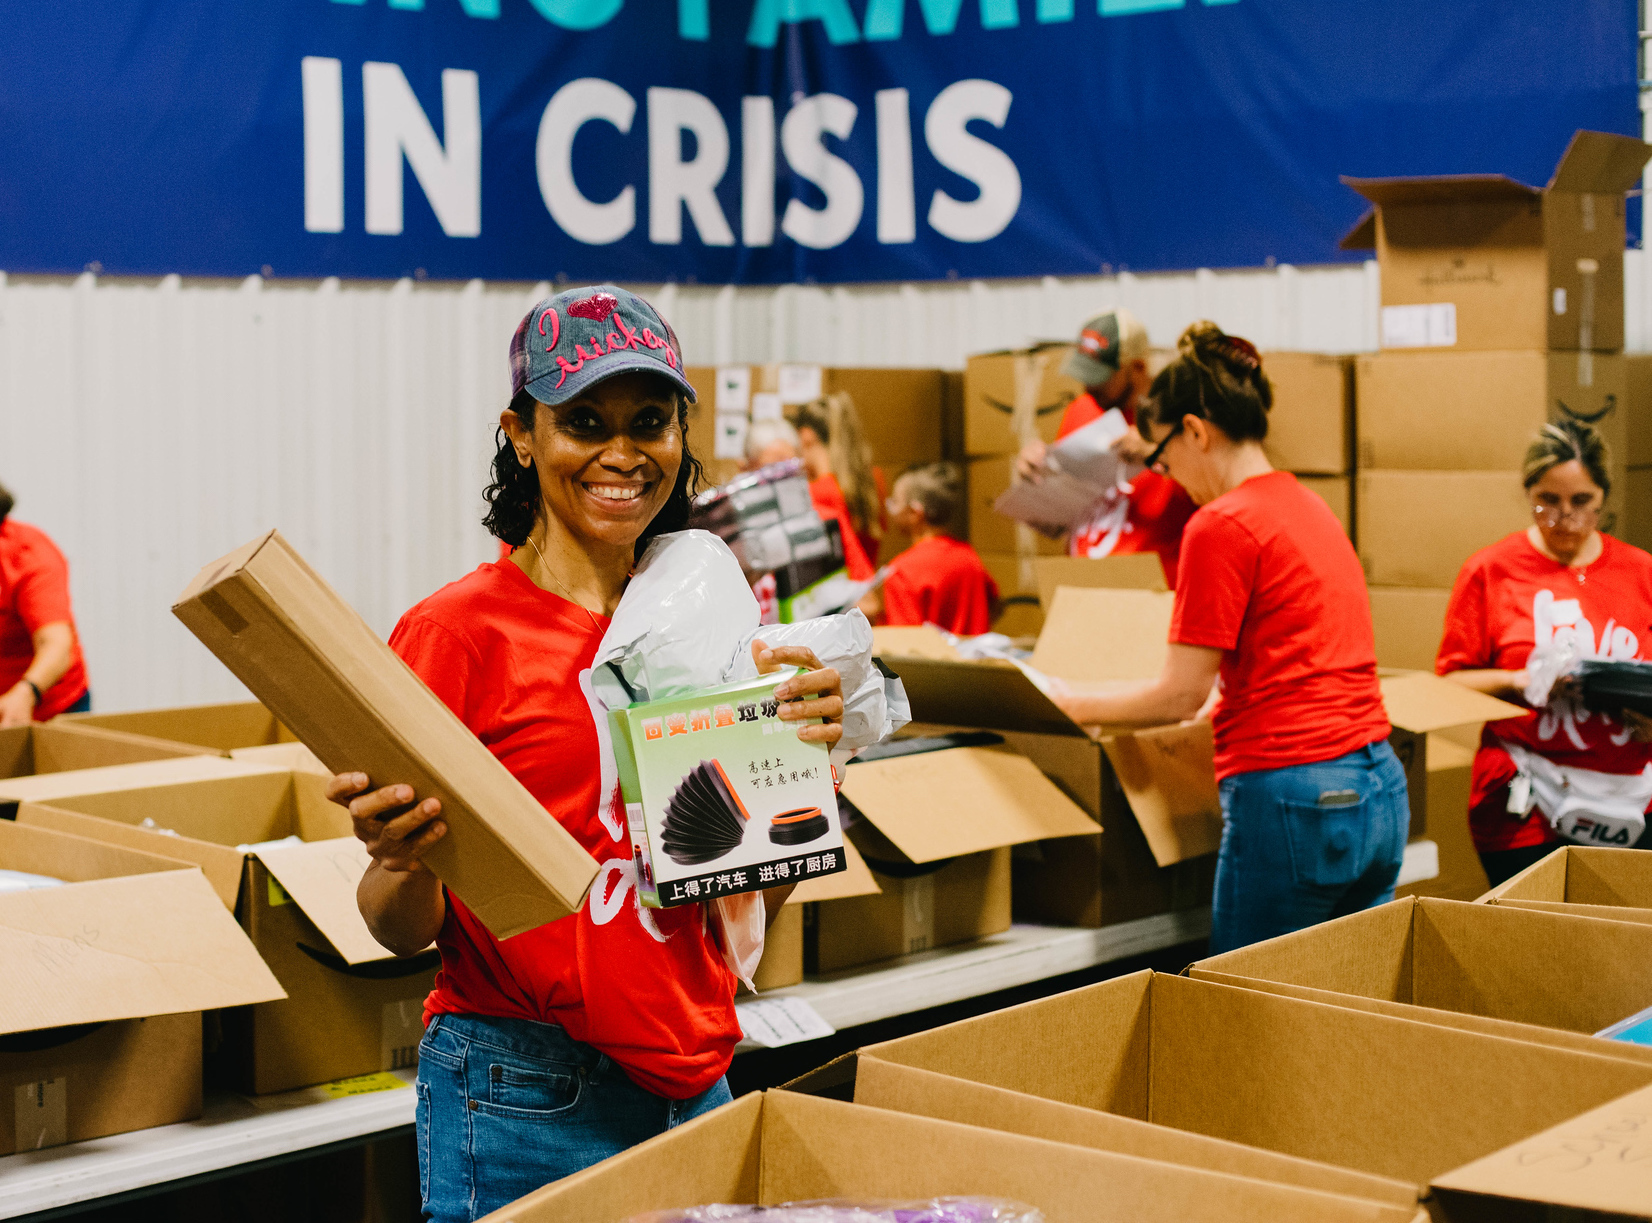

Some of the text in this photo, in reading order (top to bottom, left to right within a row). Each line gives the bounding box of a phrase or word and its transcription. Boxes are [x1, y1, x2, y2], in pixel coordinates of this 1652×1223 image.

[301, 56, 1022, 249] IN CRISIS
[538, 307, 560, 352] I
[640, 693, 804, 741] 百变折叠垃圾
[748, 757, 784, 774] 高速上
[1571, 817, 1629, 844] FILA
[669, 852, 837, 901] 上得了汽车 进得了厨房
